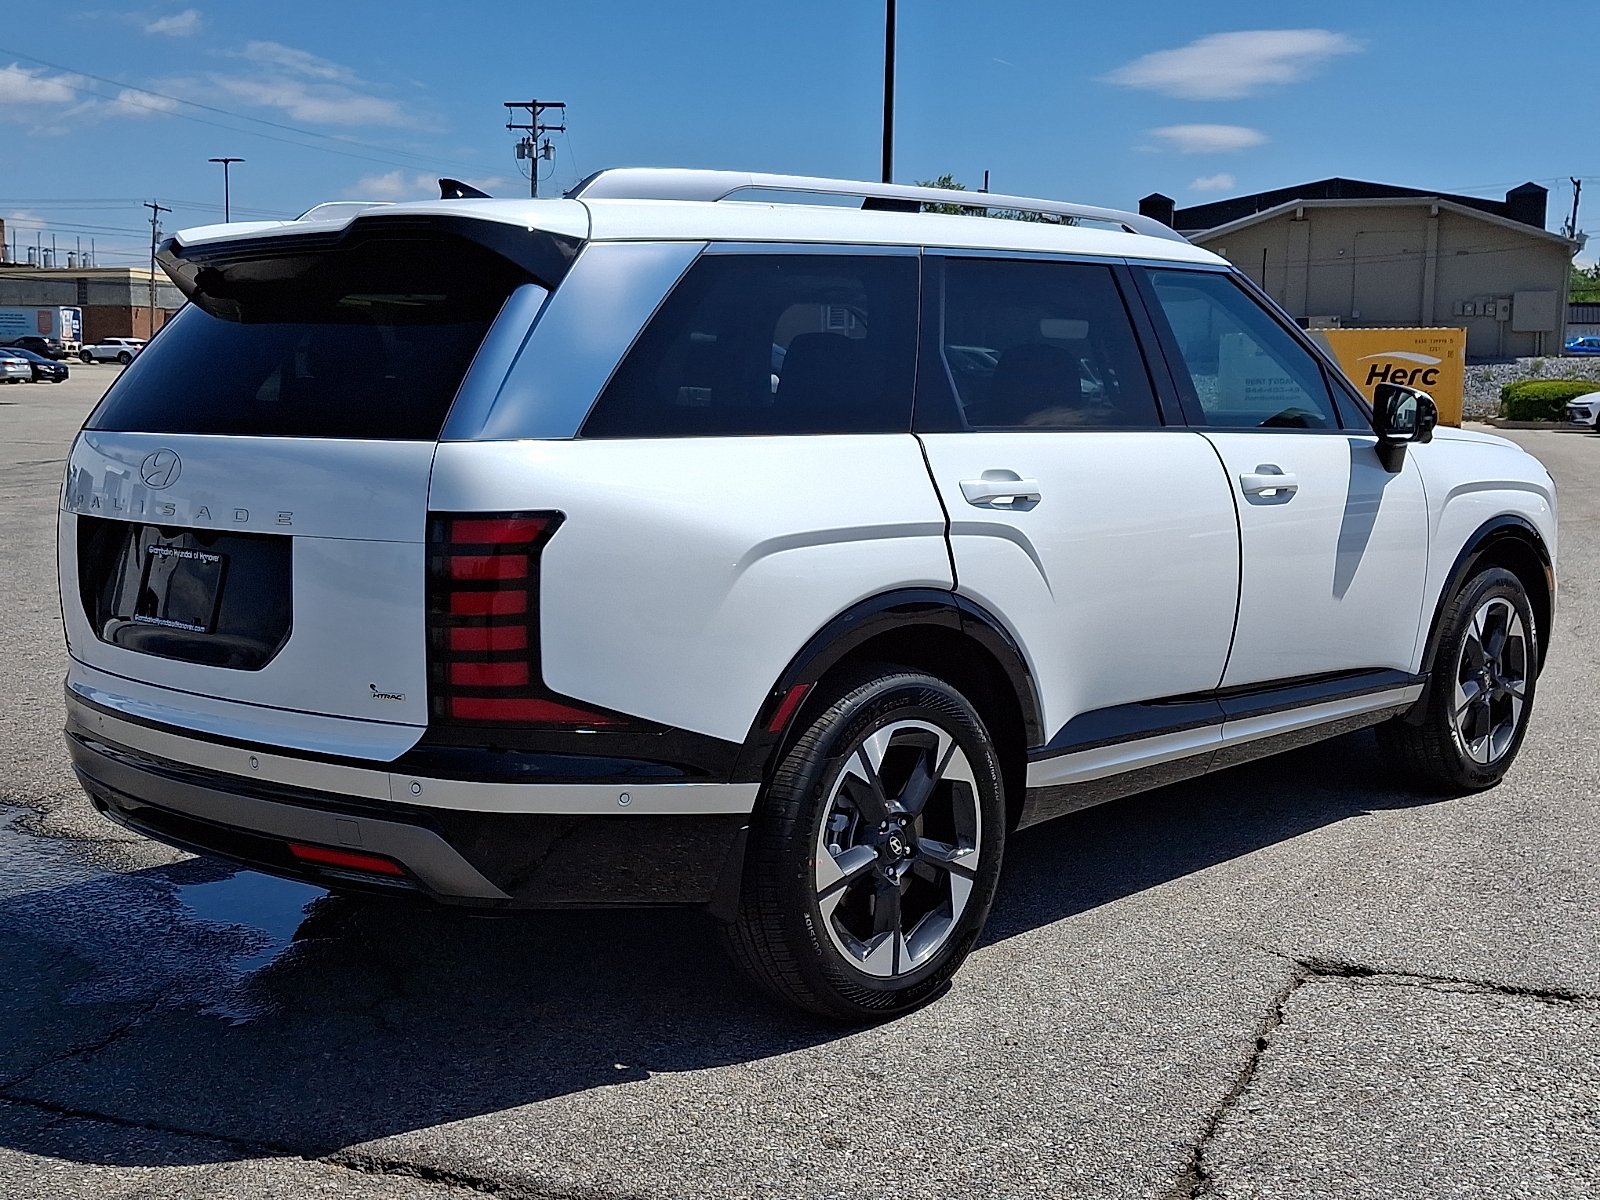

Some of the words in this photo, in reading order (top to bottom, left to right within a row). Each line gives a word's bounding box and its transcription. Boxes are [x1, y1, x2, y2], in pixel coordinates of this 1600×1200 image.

[1365, 363, 1440, 386] Herc
[77, 495, 293, 526] PALISADE
[173, 549, 192, 559] Hyundai
[193, 551, 199, 559] of
[372, 693, 402, 701] HTRAC
[803, 911, 822, 956] OUTSIDE
